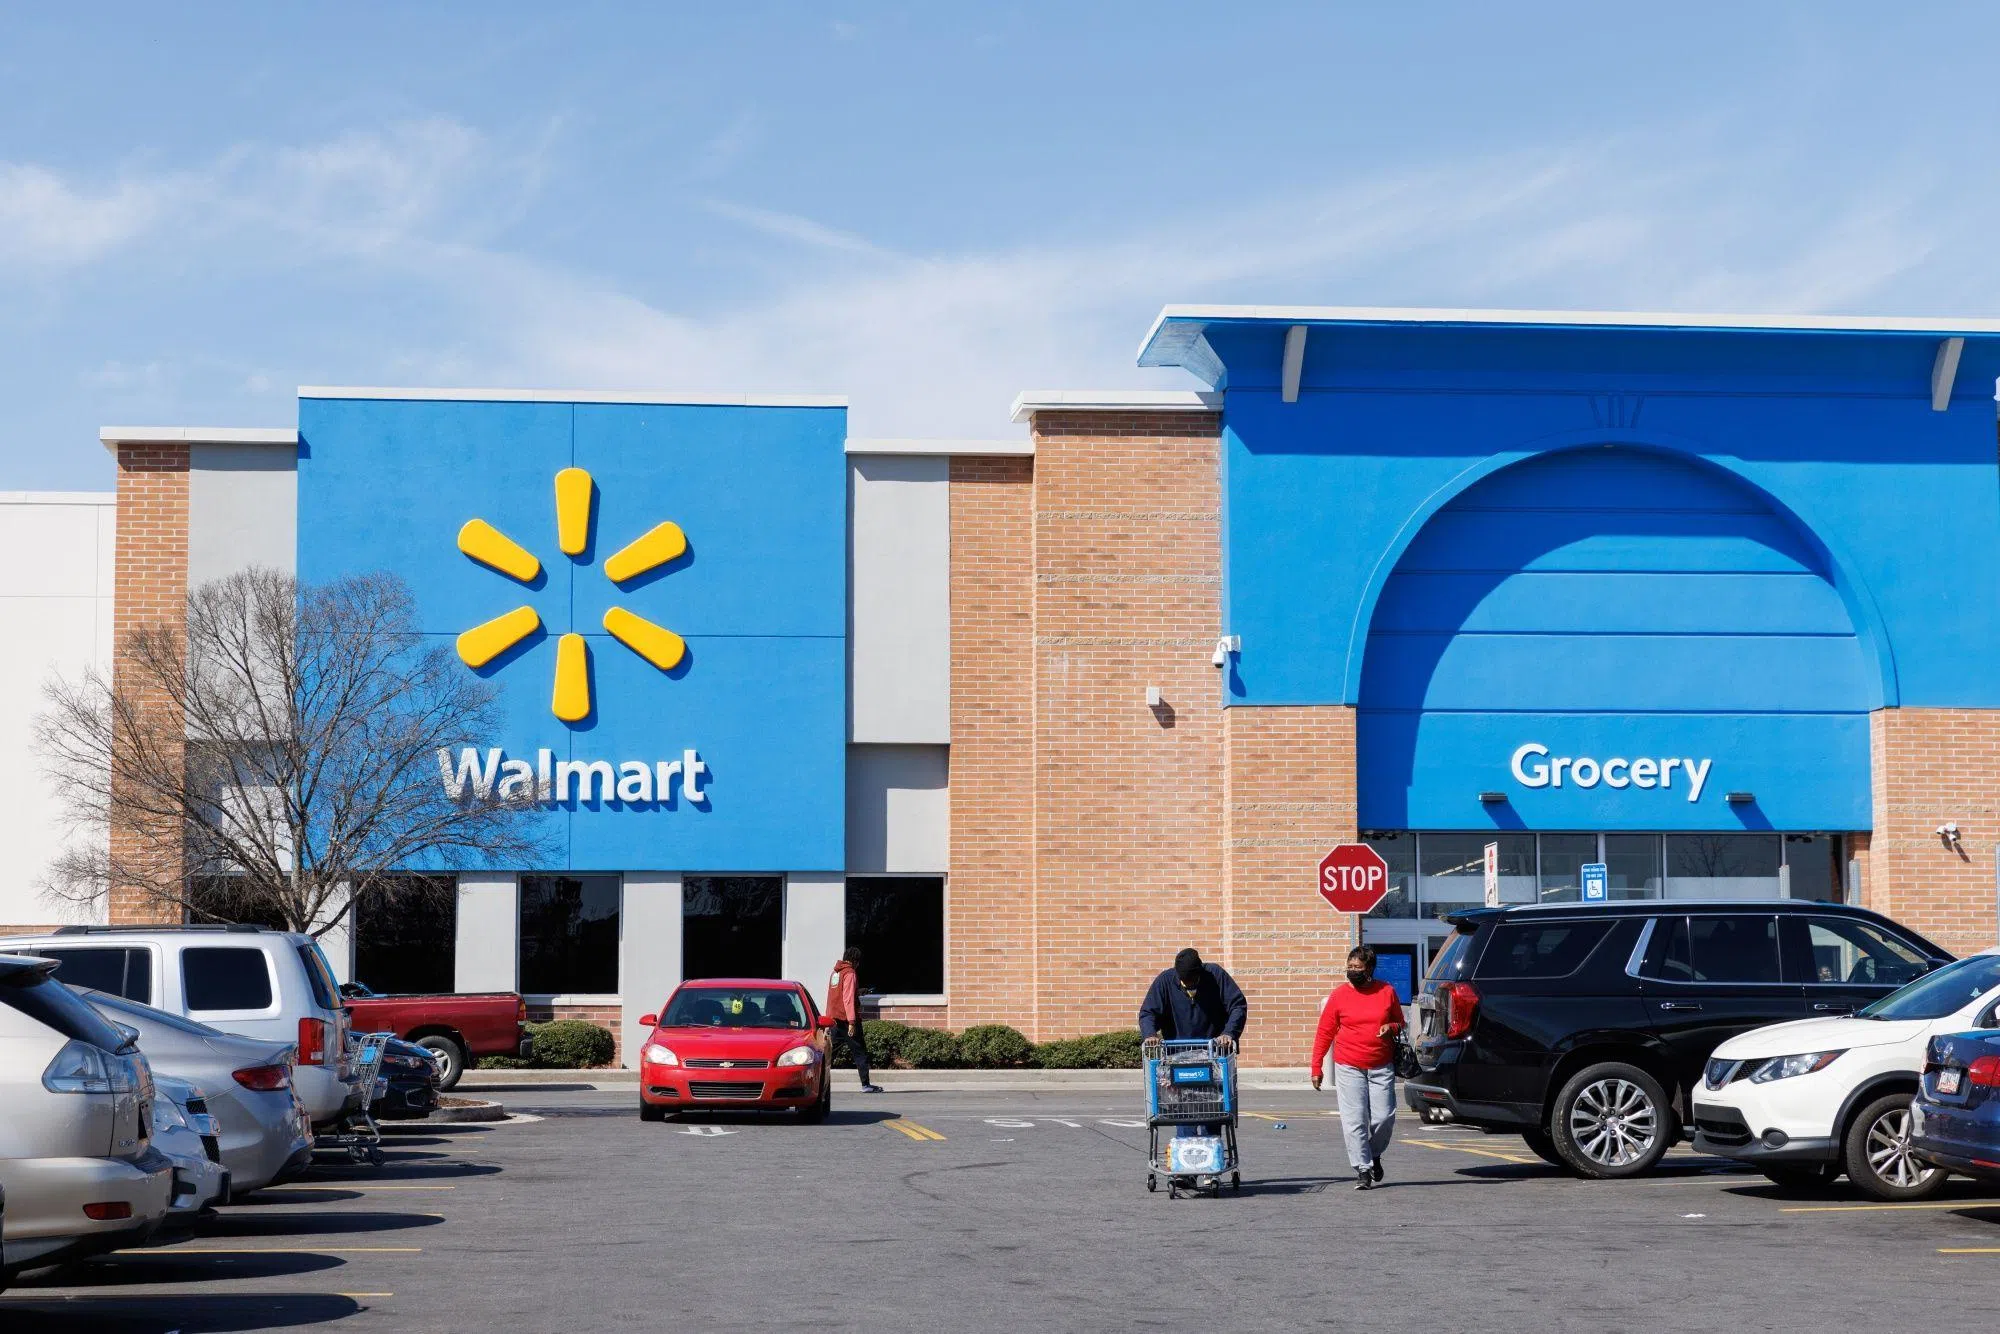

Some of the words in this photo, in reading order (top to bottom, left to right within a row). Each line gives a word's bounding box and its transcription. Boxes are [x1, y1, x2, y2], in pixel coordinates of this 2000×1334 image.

[436, 747, 705, 802] Walmart
[1511, 743, 1712, 802] Grocery
[1323, 866, 1383, 892] STOP
[983, 1118, 1147, 1128] STO
